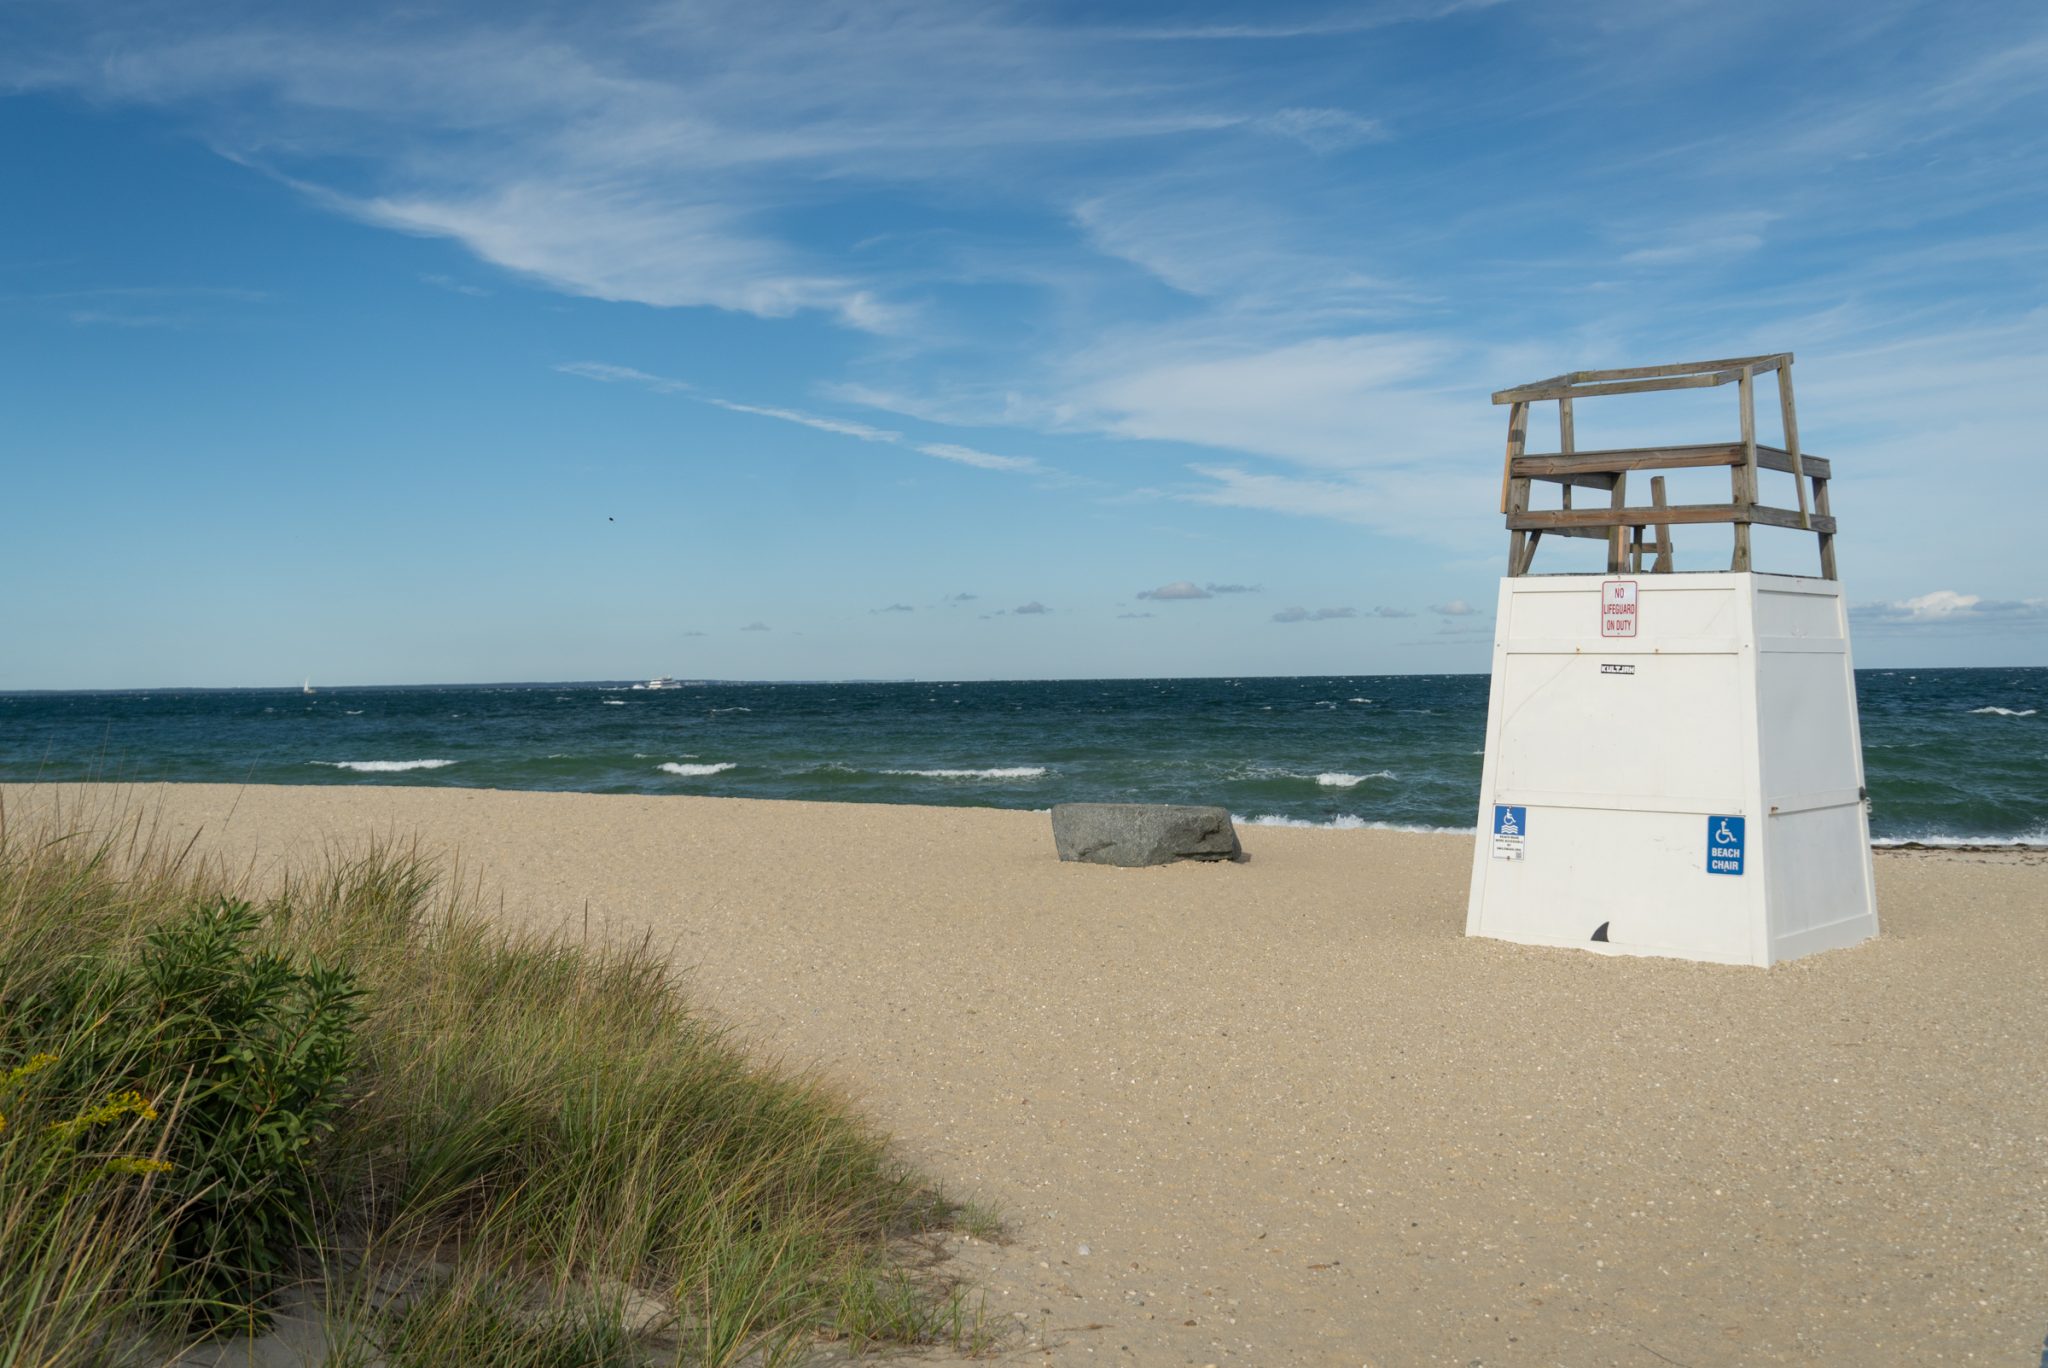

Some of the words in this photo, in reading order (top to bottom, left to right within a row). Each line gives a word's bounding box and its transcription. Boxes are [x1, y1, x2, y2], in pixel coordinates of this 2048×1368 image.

[1615, 587, 1624, 599] NO
[1604, 603, 1635, 615] LIFEGUARD
[1607, 619, 1615, 631] ON
[1616, 619, 1632, 631] DUTY
[1711, 847, 1740, 858] BEACH
[1711, 859, 1739, 870] CHAIR
